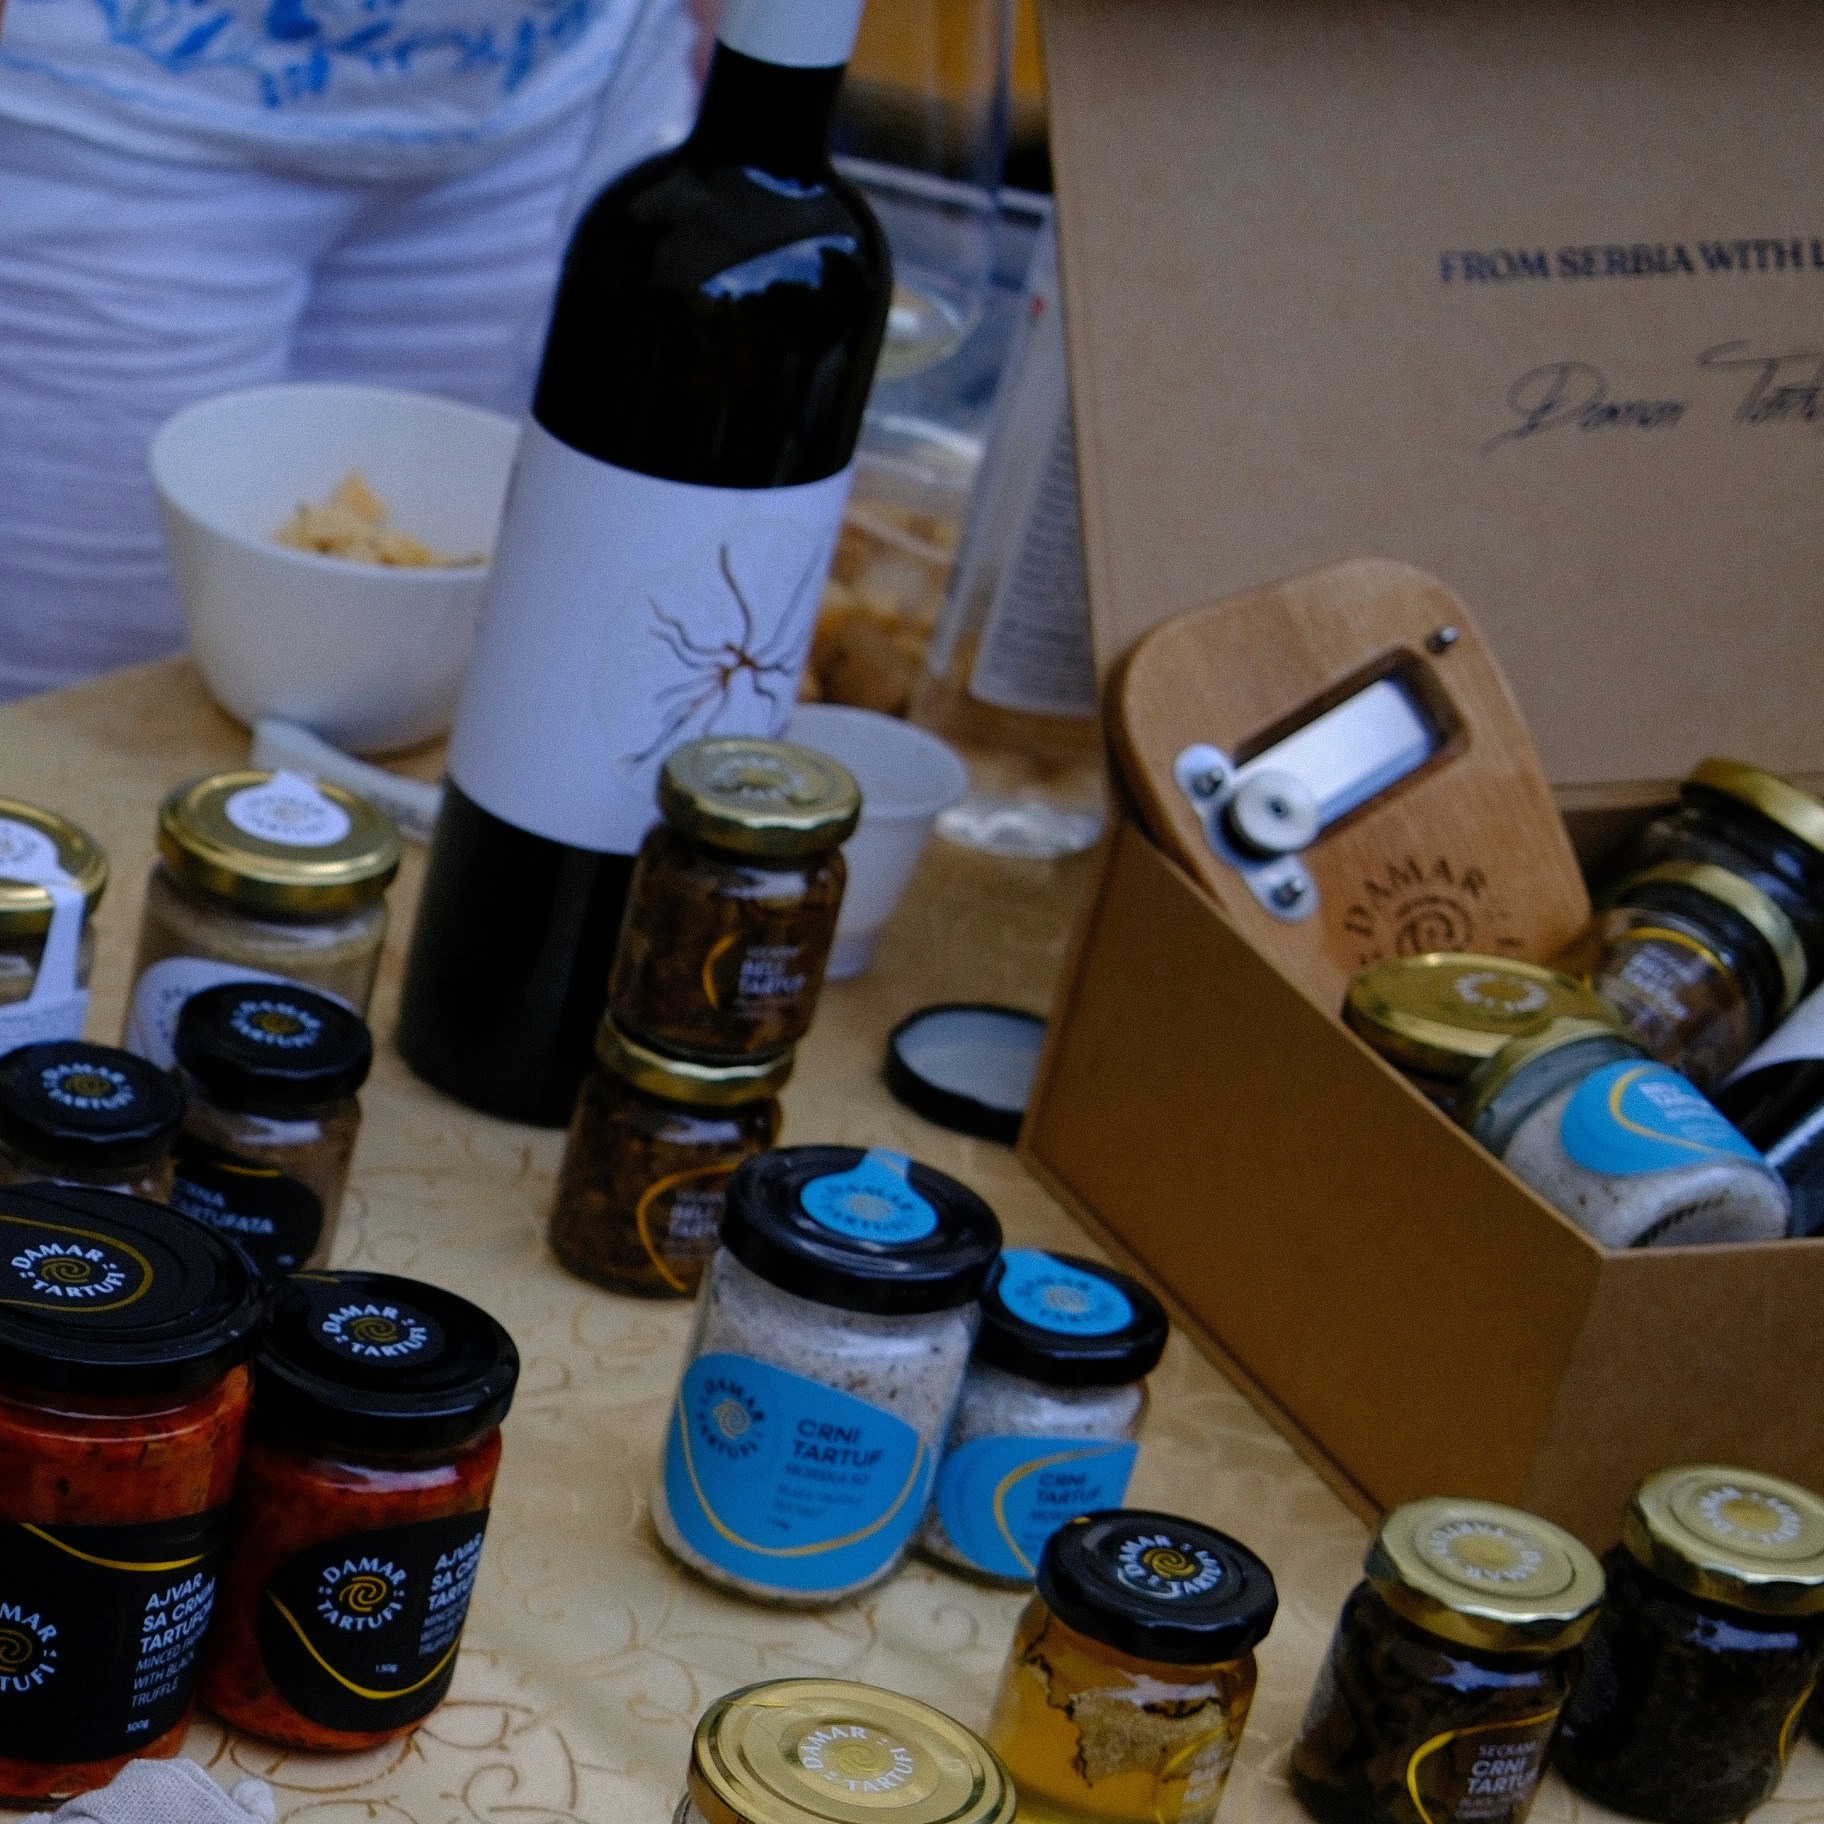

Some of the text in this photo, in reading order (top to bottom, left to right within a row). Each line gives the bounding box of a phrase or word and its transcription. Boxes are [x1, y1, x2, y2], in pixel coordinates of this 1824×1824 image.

[1439, 246, 1549, 283] FROM
[1556, 242, 1695, 279] SERBIA
[1698, 236, 1804, 273] WITH
[10, 1241, 105, 1272] DAMAR
[31, 1268, 127, 1299] TARTUFI
[321, 1301, 400, 1333] DAMAR
[351, 1325, 430, 1357] TARTUFI
[797, 1418, 861, 1444] CRNI
[322, 1556, 408, 1587] DAMAR
[145, 1571, 204, 1612] AJVAR
[142, 1611, 168, 1634] SA
[317, 1598, 403, 1633] TARTUFI
[799, 1725, 868, 1772] DAMAR
[846, 1748, 917, 1792] TARTUFI
